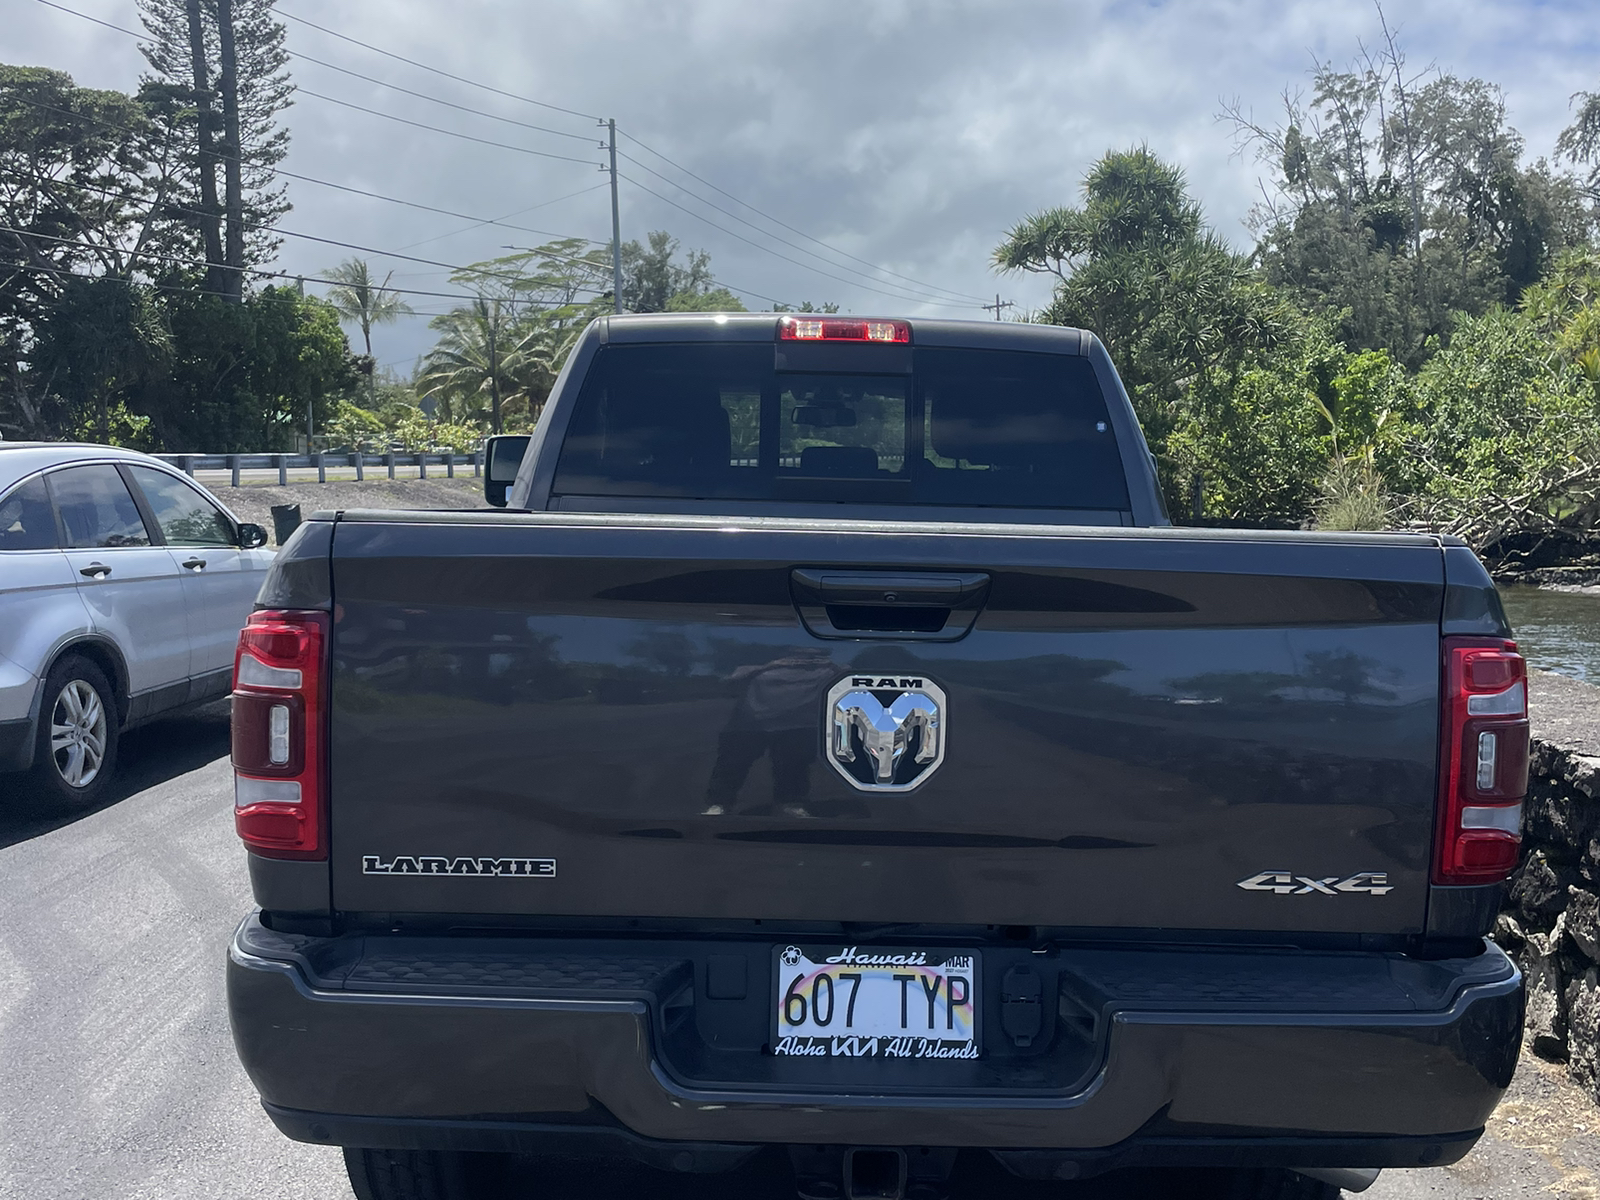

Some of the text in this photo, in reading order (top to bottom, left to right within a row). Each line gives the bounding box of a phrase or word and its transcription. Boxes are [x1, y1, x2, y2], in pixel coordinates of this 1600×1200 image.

[852, 678, 923, 688] RAM
[363, 856, 556, 877] LARAMIE
[1237, 871, 1394, 895] 4x4
[826, 946, 927, 966] Hawaii
[945, 955, 970, 968] MAR
[784, 973, 970, 1030] 607 TYP
[774, 1036, 827, 1057] Aloha
[884, 1037, 912, 1058] All
[915, 1038, 980, 1060] Islands
